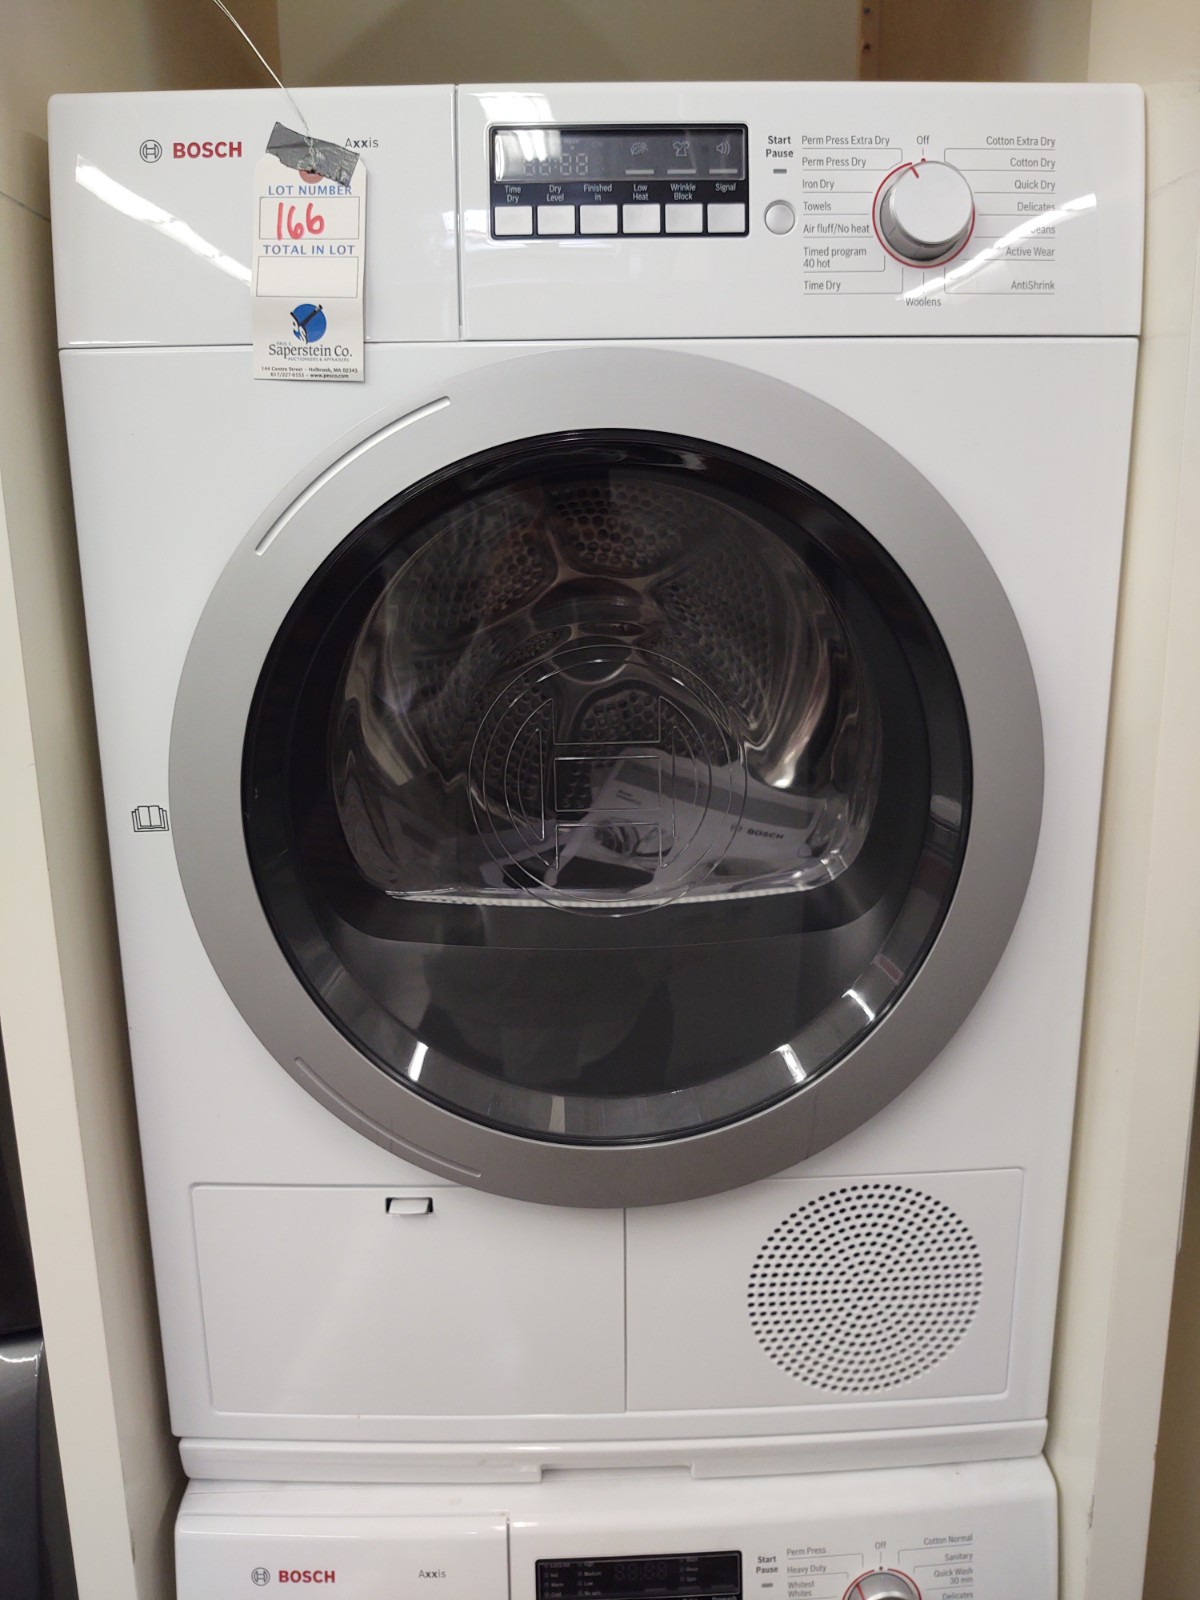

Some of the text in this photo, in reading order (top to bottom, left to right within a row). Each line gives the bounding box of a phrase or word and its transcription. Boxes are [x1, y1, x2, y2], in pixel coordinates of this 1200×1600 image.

[345, 137, 379, 149] Axxis
[767, 135, 792, 145] Start
[801, 136, 890, 147] Perm Press Extra Dry
[916, 135, 930, 145] Off
[986, 136, 1056, 148] Cotton Extra Dry
[172, 141, 243, 160] BOSCH
[765, 148, 794, 158] Pause
[802, 157, 867, 169] Perm Press Dry
[1010, 158, 1056, 169] Cotton Dry
[268, 185, 353, 196] LOT NUMBER
[504, 185, 522, 194] Time
[549, 185, 562, 195] Dry
[583, 184, 613, 193] Finished
[633, 183, 648, 192] Low
[670, 183, 696, 192] Wrinkle
[715, 183, 736, 193] Signal
[802, 180, 835, 191] Iron Dry
[1014, 180, 1056, 192] Quick Dry
[507, 194, 520, 204] Dry
[546, 193, 565, 202] Level
[632, 192, 649, 201] Heat
[674, 192, 693, 201] Block
[803, 202, 832, 211] Towels
[1017, 201, 1056, 212] Delicates
[275, 202, 326, 241] 166
[803, 223, 870, 234] Air fluff/No heat
[263, 245, 356, 255] TOTAL IN LOT
[803, 247, 867, 259] Timed program
[1006, 246, 1056, 257] Active Wear
[803, 259, 831, 269] 40 hot
[804, 281, 841, 292] Time Dry
[1011, 281, 1056, 290] AntiShrink
[905, 297, 941, 307] Woolens
[269, 344, 353, 359] Saperstein Co.
[747, 828, 785, 840] BOSCH
[923, 1534, 973, 1546] Cotton Normal
[875, 1541, 887, 1550] Off
[787, 1546, 827, 1556] Perm Press
[757, 1555, 777, 1564] Start
[944, 1552, 973, 1563] Sanitary
[418, 1569, 446, 1579] Axxis
[756, 1565, 779, 1574] Pause
[787, 1564, 827, 1576] Heavy Duty
[933, 1567, 974, 1578] Quick Wash
[278, 1570, 336, 1583] BOSCH
[950, 1576, 974, 1585] 30 min
[788, 1581, 815, 1589] Whitest
[788, 1590, 812, 1598] Whites
[942, 1592, 974, 1600] Delicates
